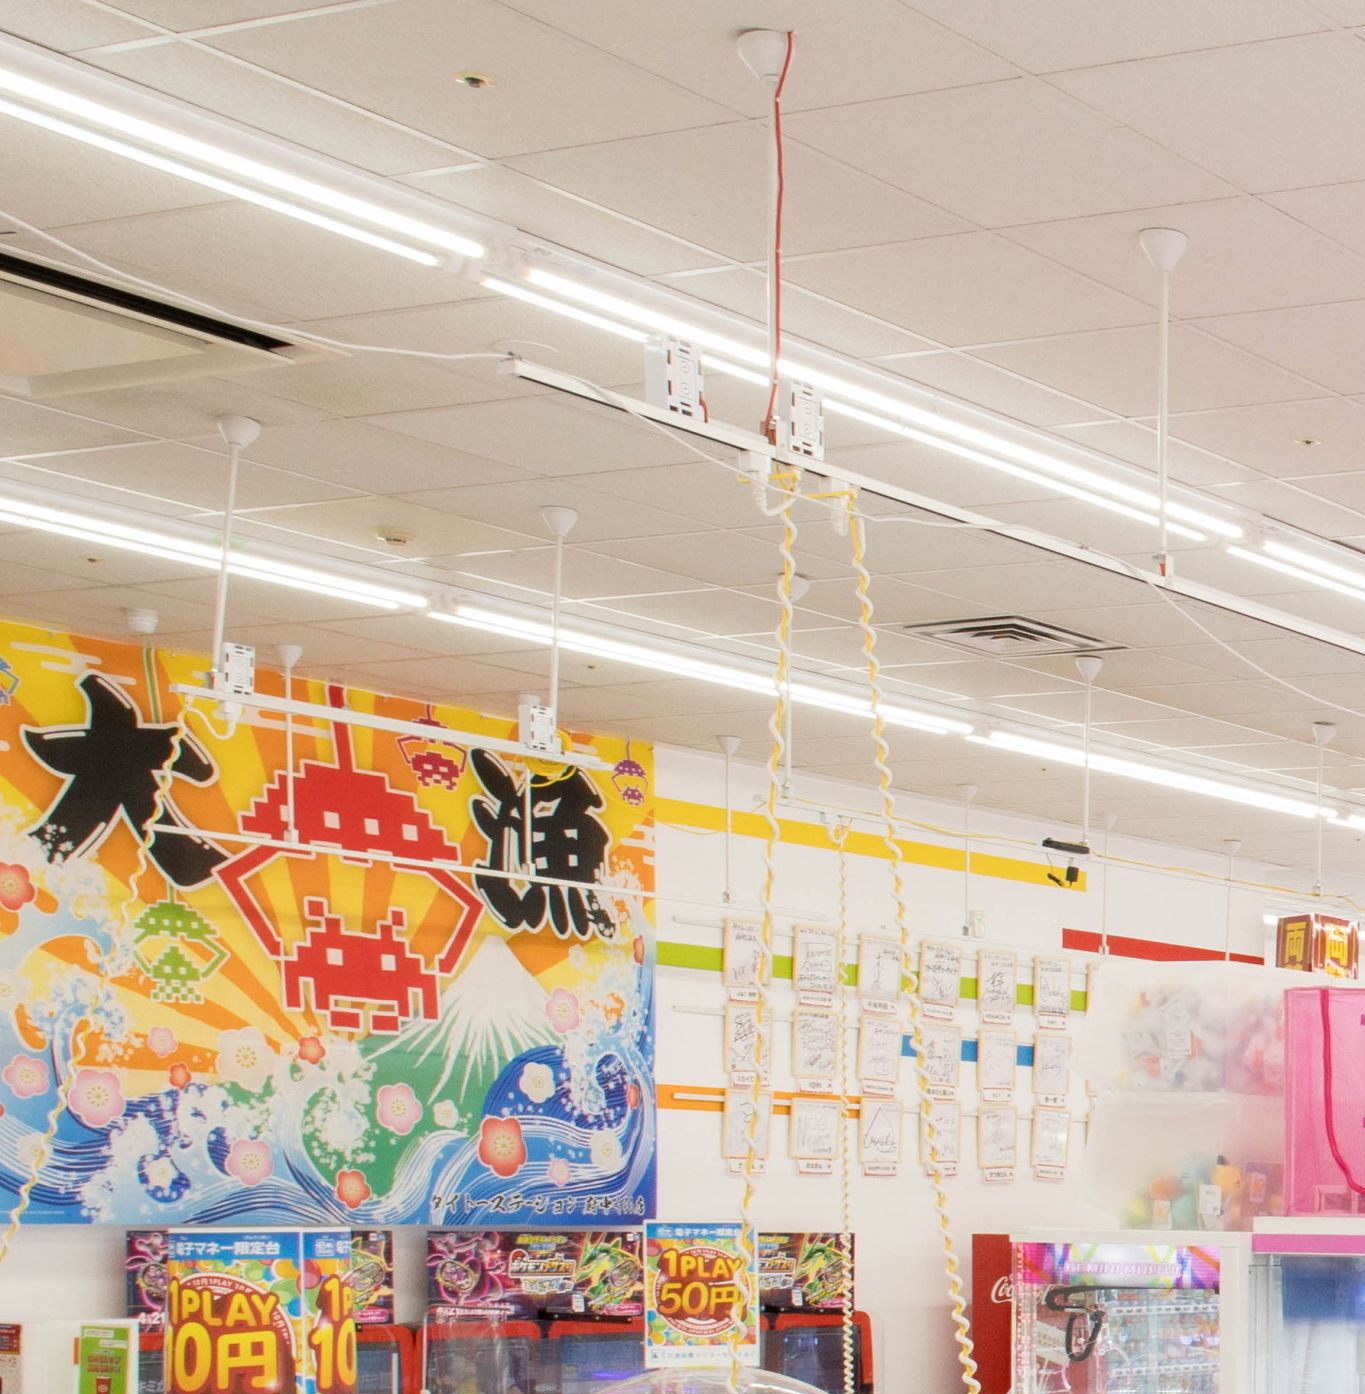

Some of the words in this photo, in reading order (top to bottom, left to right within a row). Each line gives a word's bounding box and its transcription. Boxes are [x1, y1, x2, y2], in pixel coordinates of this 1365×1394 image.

[20, 670, 233, 888] 大
[469, 746, 618, 939] 漁
[663, 1249, 743, 1278] 1PLAY
